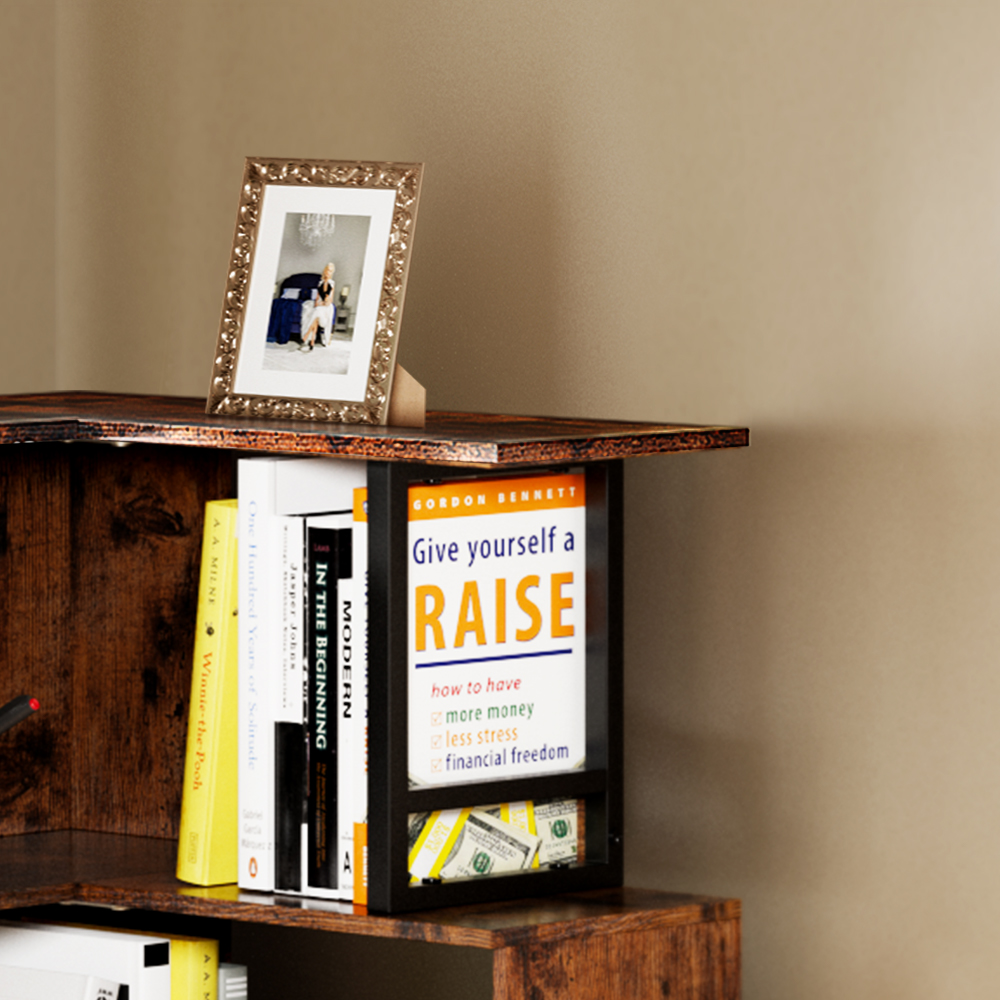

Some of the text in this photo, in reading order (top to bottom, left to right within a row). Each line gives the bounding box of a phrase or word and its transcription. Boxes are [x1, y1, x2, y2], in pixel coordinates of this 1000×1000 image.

[413, 486, 576, 511] GORDON BENNETT
[412, 525, 575, 567] Give yourself a
[207, 556, 218, 605] MILNE
[316, 562, 328, 586] IN
[289, 563, 298, 671] Jasper Johns
[316, 590, 327, 631] THE
[415, 571, 575, 652] RAISE
[342, 601, 352, 719] MODERN
[315, 635, 328, 750] BEGINNING
[431, 677, 522, 698] how to have
[193, 651, 213, 791] Winnie-the-Pooh
[446, 702, 534, 723] more money
[446, 727, 518, 748] less stress
[446, 743, 569, 771] financial freedom
